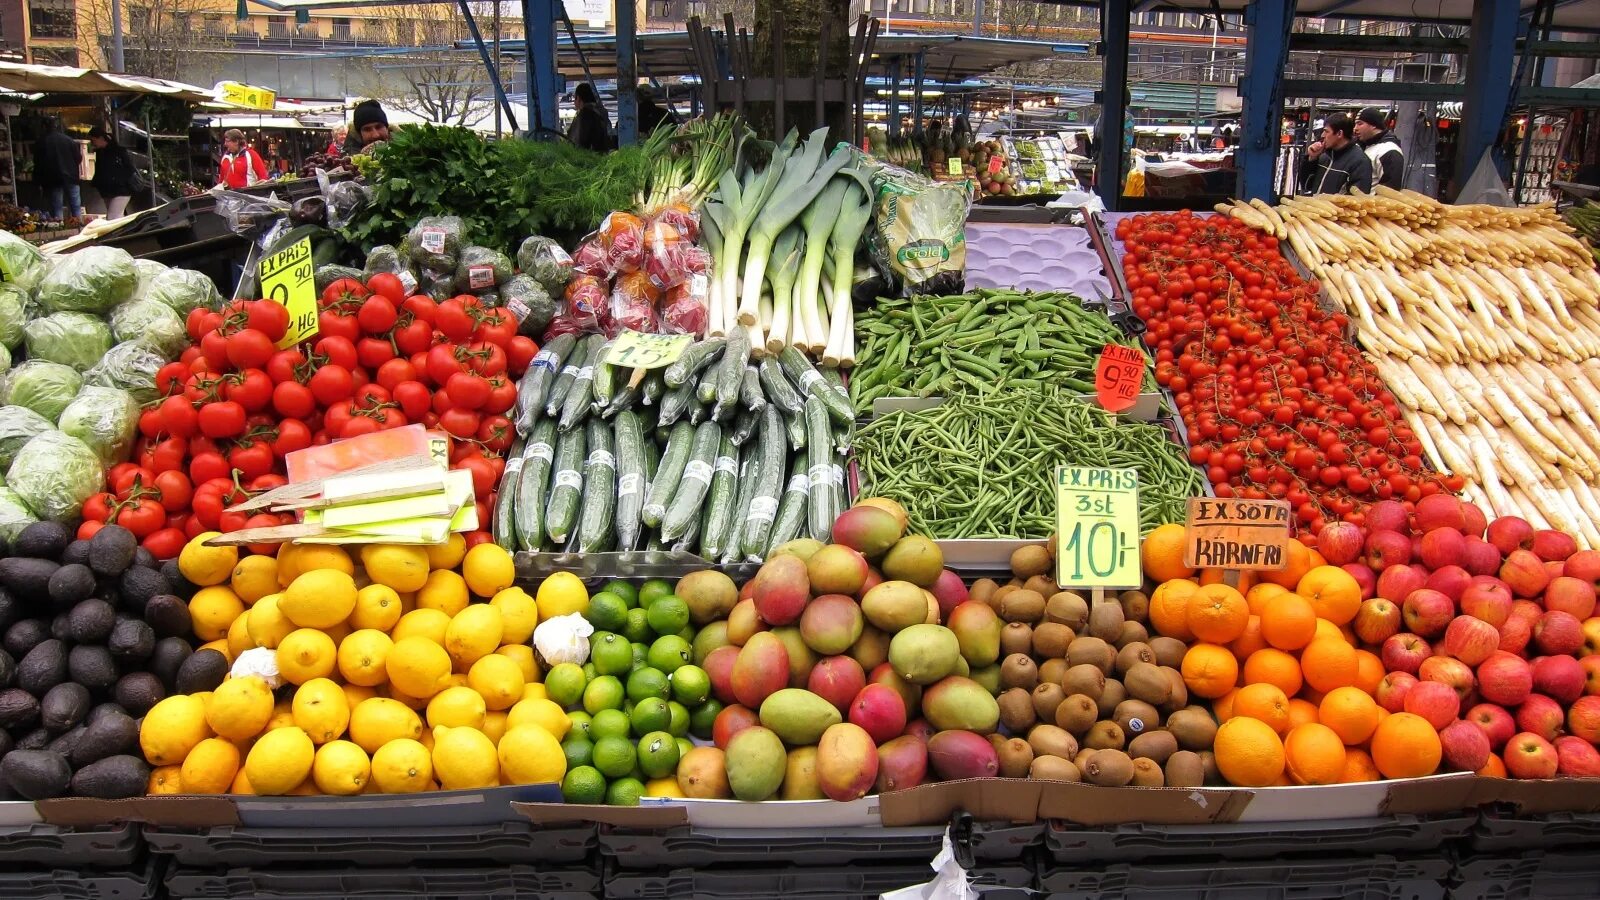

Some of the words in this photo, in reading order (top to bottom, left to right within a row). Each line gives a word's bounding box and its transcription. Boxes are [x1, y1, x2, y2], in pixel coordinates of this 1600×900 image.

[905, 246, 942, 260] Gold
[294, 263, 312, 283] 90
[298, 311, 316, 332] HG
[1103, 364, 1121, 390] 9
[1123, 365, 1139, 379] 90
[1118, 383, 1135, 398] HG
